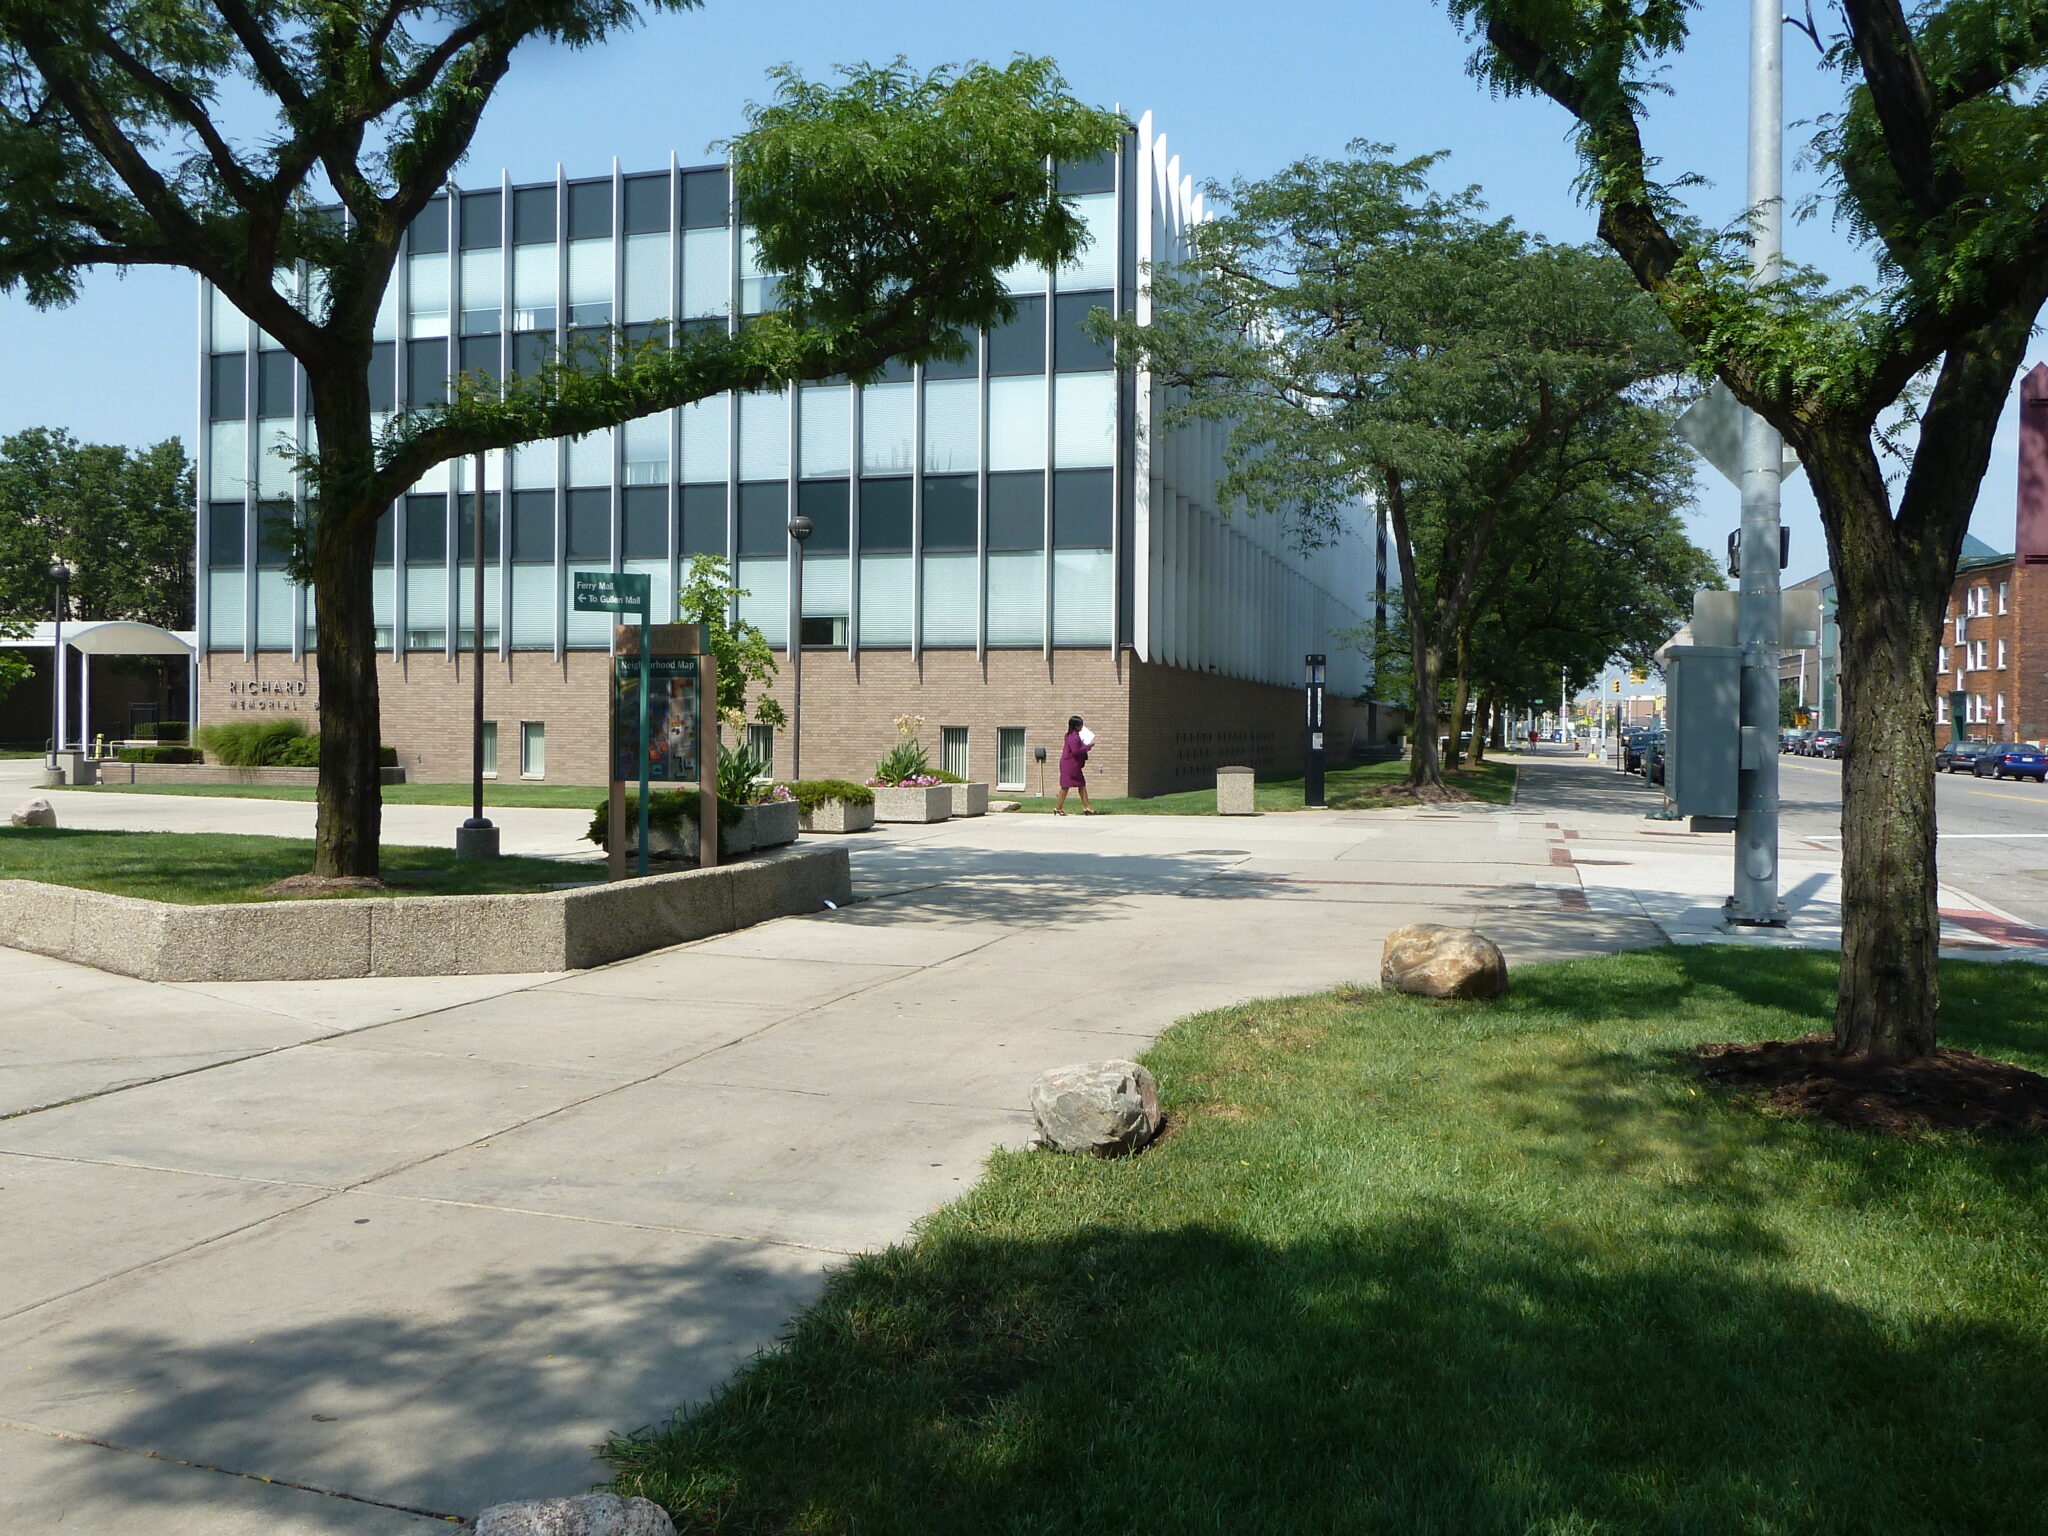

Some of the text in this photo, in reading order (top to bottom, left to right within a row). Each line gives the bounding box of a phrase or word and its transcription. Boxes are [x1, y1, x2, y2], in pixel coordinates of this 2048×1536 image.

[577, 581, 614, 591] Ferry Mall
[588, 595, 598, 603] To
[625, 596, 641, 605] Mall
[621, 660, 694, 671] Neighorhood Map
[230, 680, 305, 695] RICHARD
[230, 700, 298, 711] MEMORIAL
